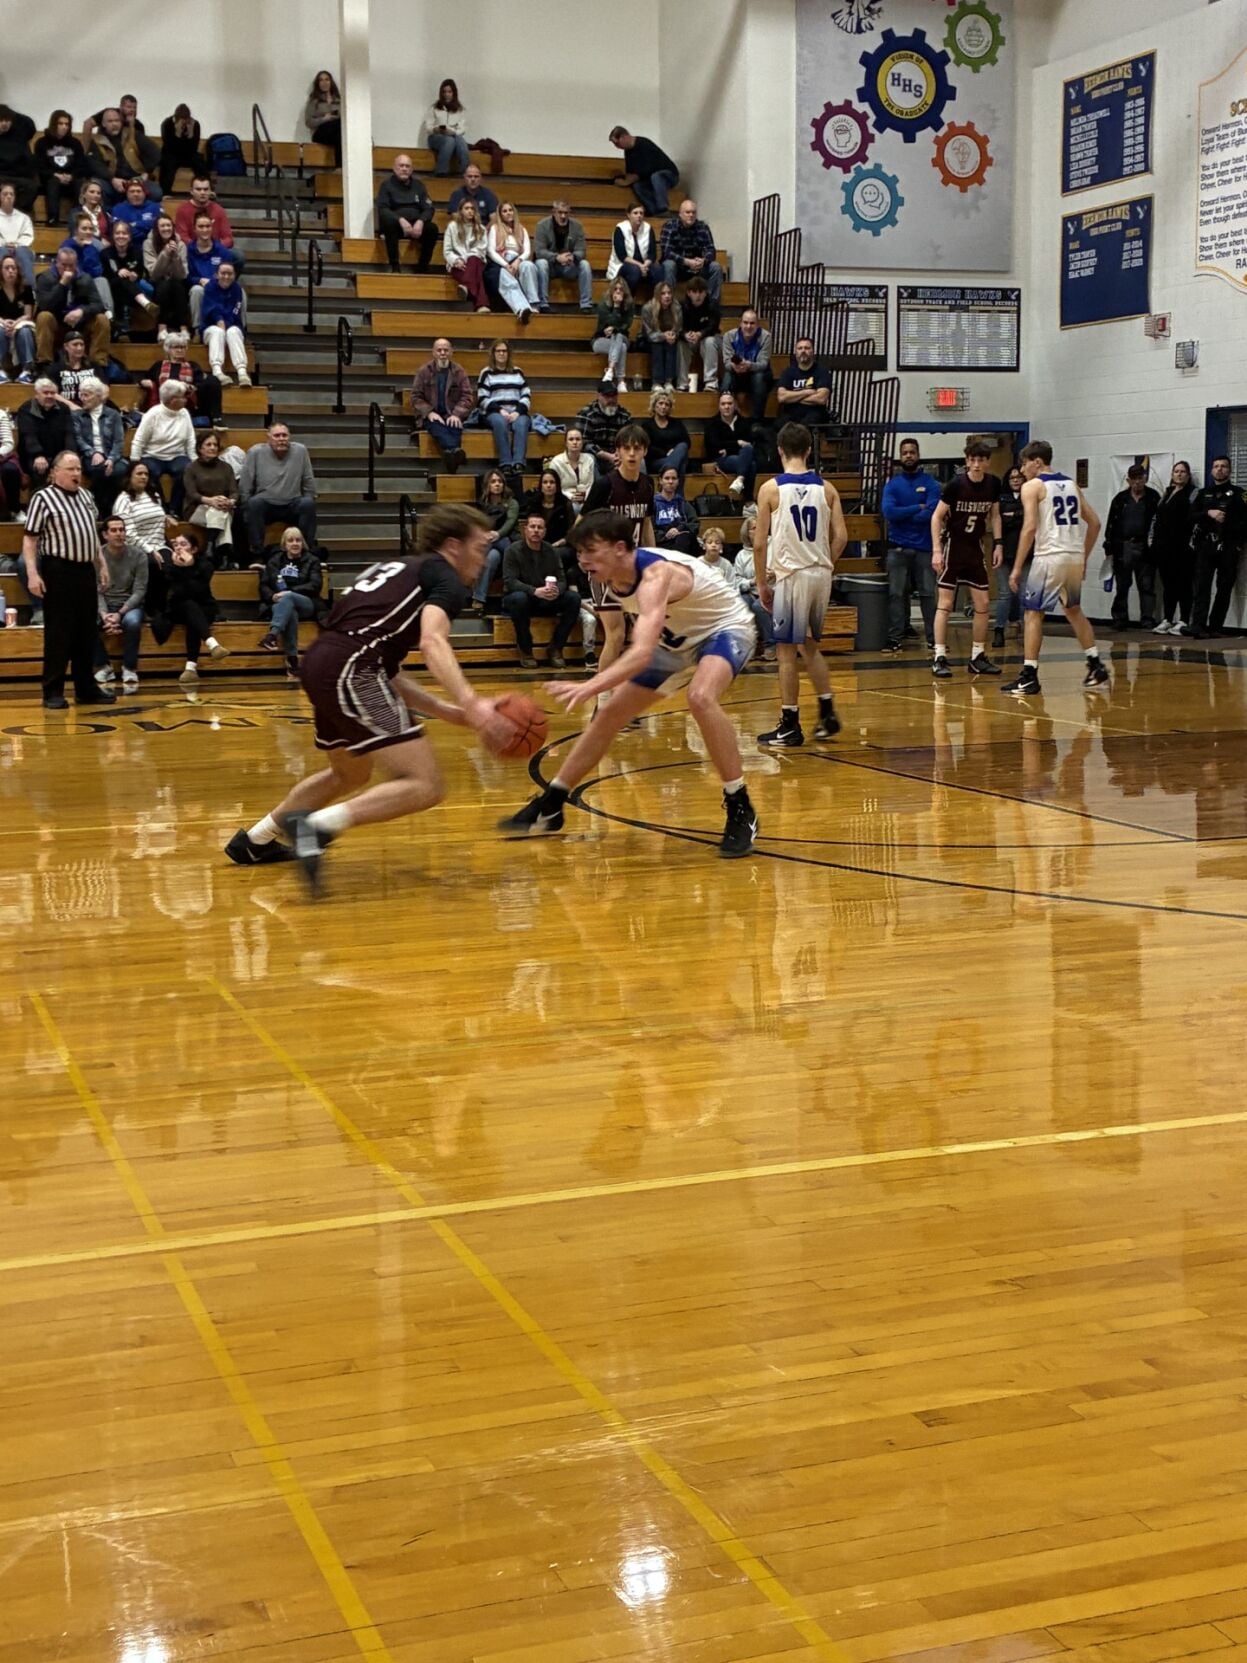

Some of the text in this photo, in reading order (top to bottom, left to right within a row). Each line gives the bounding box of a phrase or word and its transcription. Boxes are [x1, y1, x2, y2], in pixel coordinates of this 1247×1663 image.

[891, 72, 923, 98] HHS
[790, 504, 818, 542] 10
[964, 515, 978, 533] 5
[1053, 495, 1079, 526] 22
